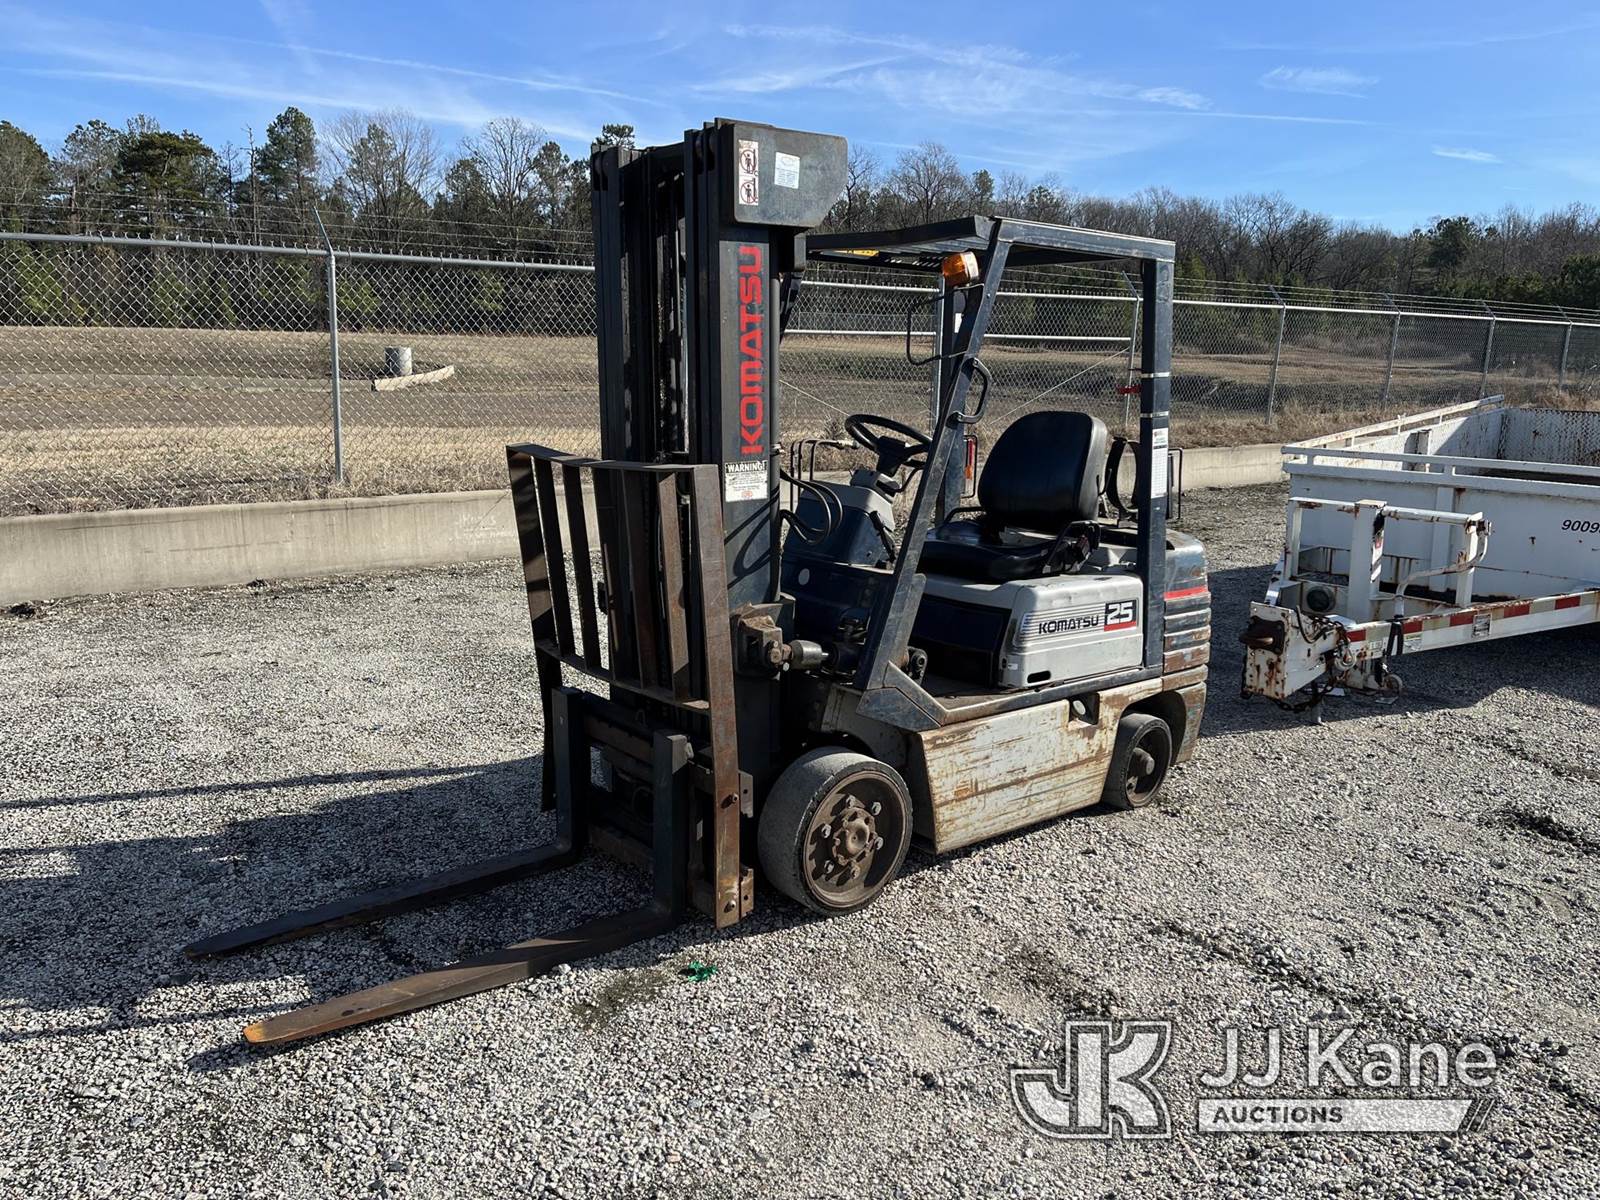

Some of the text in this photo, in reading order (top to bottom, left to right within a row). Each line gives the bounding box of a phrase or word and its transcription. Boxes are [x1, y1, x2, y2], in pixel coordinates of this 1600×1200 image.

[739, 246, 763, 455] KOMATSU
[1561, 519, 1600, 534] 9009
[1038, 601, 1134, 634] KOMATSU 25
